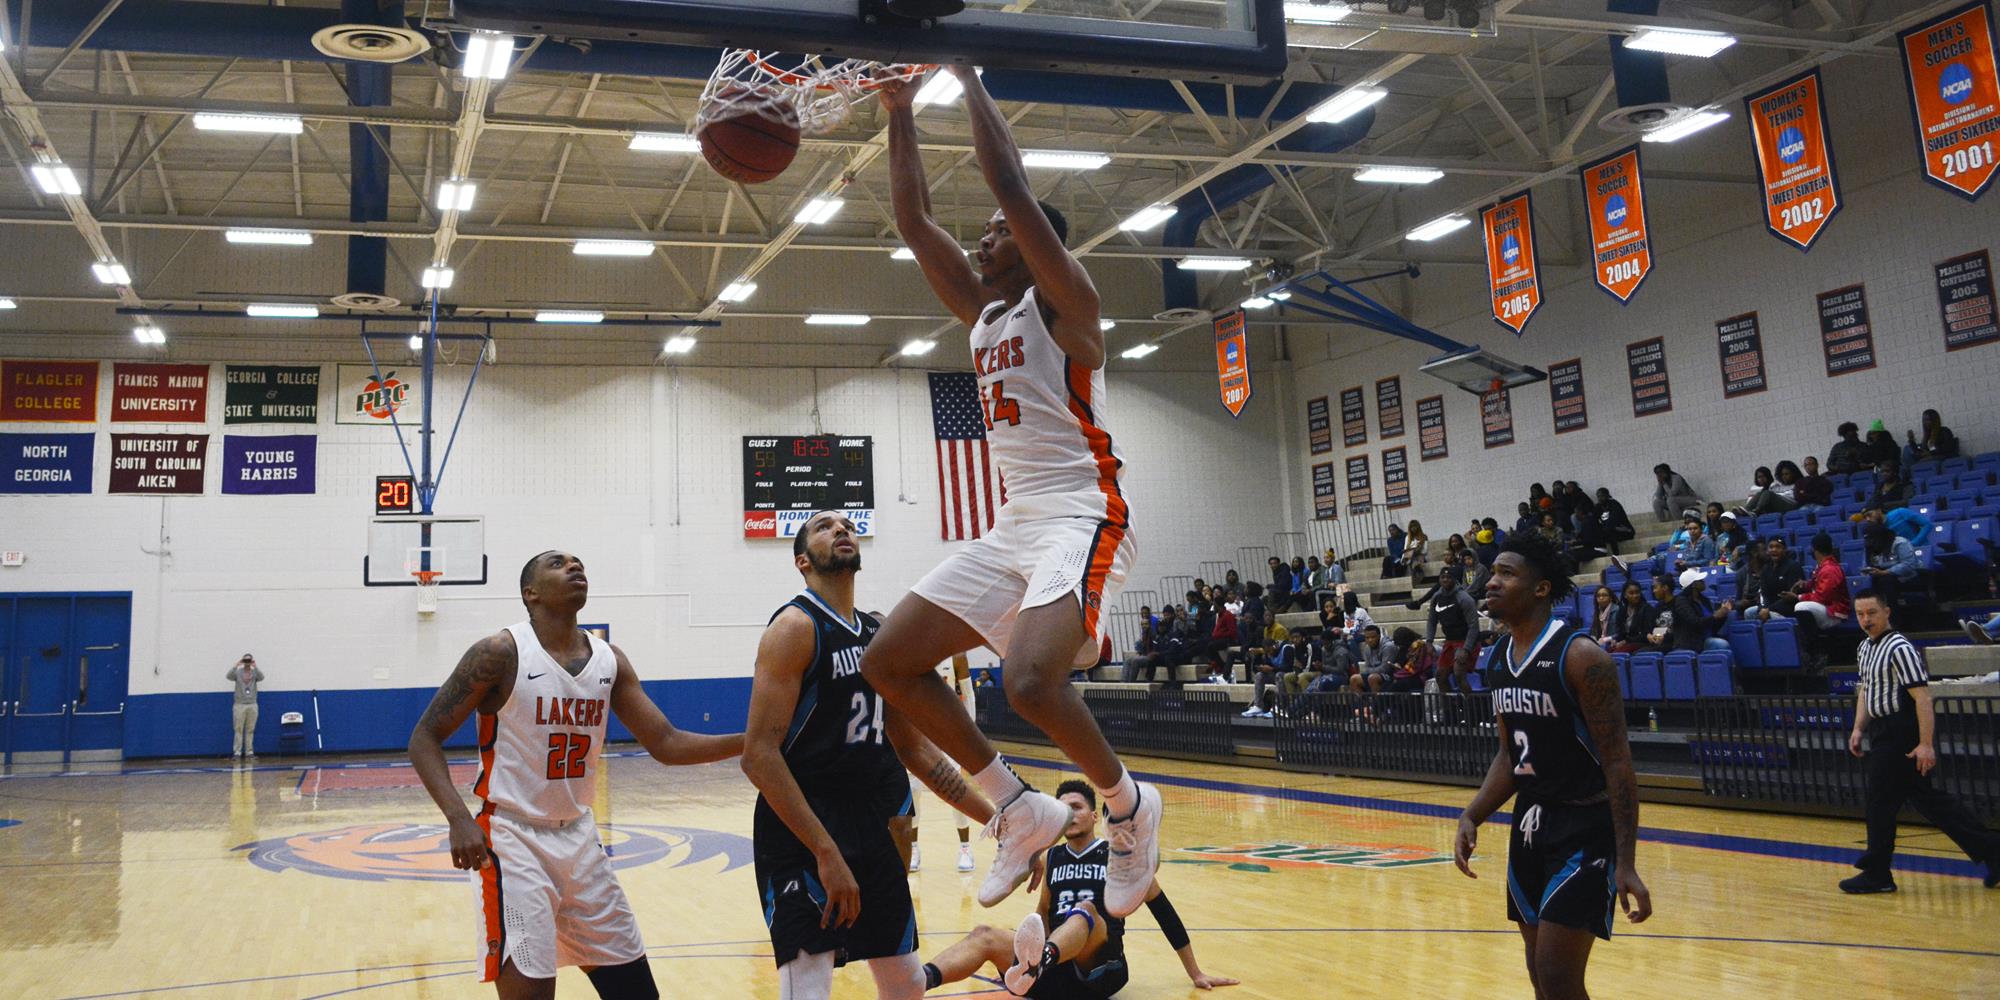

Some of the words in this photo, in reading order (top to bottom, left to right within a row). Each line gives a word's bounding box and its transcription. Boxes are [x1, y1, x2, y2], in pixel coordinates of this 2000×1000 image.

[1928, 21, 1965, 47] MEN'S
[1925, 37, 1973, 66] SOCCER
[1942, 78, 1972, 98] NCAA
[1760, 85, 1808, 115] WOMEN'S
[1768, 104, 1804, 128] TENNIS
[1928, 119, 1956, 134] NATIONAL
[1928, 130, 1960, 152] SWEET
[1961, 115, 2000, 141] SIXTEEN
[1780, 140, 1805, 158] NCAA
[1942, 140, 1993, 178] 2001
[1600, 162, 1623, 180] MEN'S
[1597, 176, 1629, 195] SOCCER
[1771, 189, 1794, 206] WEET
[1796, 175, 1828, 198] SIXTEEN
[1608, 207, 1627, 222] NCAA
[1781, 197, 1824, 230] 2002
[1598, 248, 1618, 264] SWEET
[1619, 240, 1646, 258] SIXTEEN
[1606, 258, 1640, 285] 2004
[1939, 263, 1962, 277] PEACH
[1965, 259, 1983, 271] BELT
[1940, 269, 1986, 288] CONFERENCE
[1823, 296, 1842, 307] PEACH
[1844, 291, 1860, 301] BELT
[1951, 284, 1978, 299] 2005
[1502, 293, 1531, 319] 2005
[1823, 301, 1862, 317] CONFERENCE
[1720, 323, 1738, 334] PEACH
[1832, 315, 1856, 328] 2005
[1721, 328, 1755, 342] CONFERENCE
[1729, 341, 1750, 353] 2005
[974, 336, 1025, 379] KERS
[16, 373, 84, 386] FLAGLER
[118, 374, 159, 387] FRANCIS
[168, 375, 204, 388] MARION
[227, 371, 267, 384] GEORGIA
[277, 372, 318, 385] COLLEGE
[15, 397, 82, 409] COLLEGE
[120, 398, 197, 411] UNIVERSITY
[356, 383, 410, 412] PBC
[225, 405, 253, 417] STATE
[261, 405, 316, 417] UNIVERSITY
[120, 439, 178, 452] UNIVERSITY
[186, 440, 200, 452] OF
[748, 439, 778, 448] GUEST
[839, 439, 865, 447] HOME
[23, 446, 67, 458] NORTH
[245, 451, 295, 463] YOUNG
[115, 457, 146, 470] SOUTH
[155, 458, 201, 470] CAROLINA
[15, 469, 72, 481] GEORGIA
[138, 475, 176, 488] AIKEN
[241, 467, 297, 480] HARRIS
[379, 482, 408, 506] 20
[846, 511, 872, 519] THE
[535, 696, 605, 727] LAKERS
[845, 691, 884, 744] 24
[546, 732, 591, 780] 22
[1514, 731, 1536, 776] 2
[1051, 864, 1107, 884] AUGUSTA
